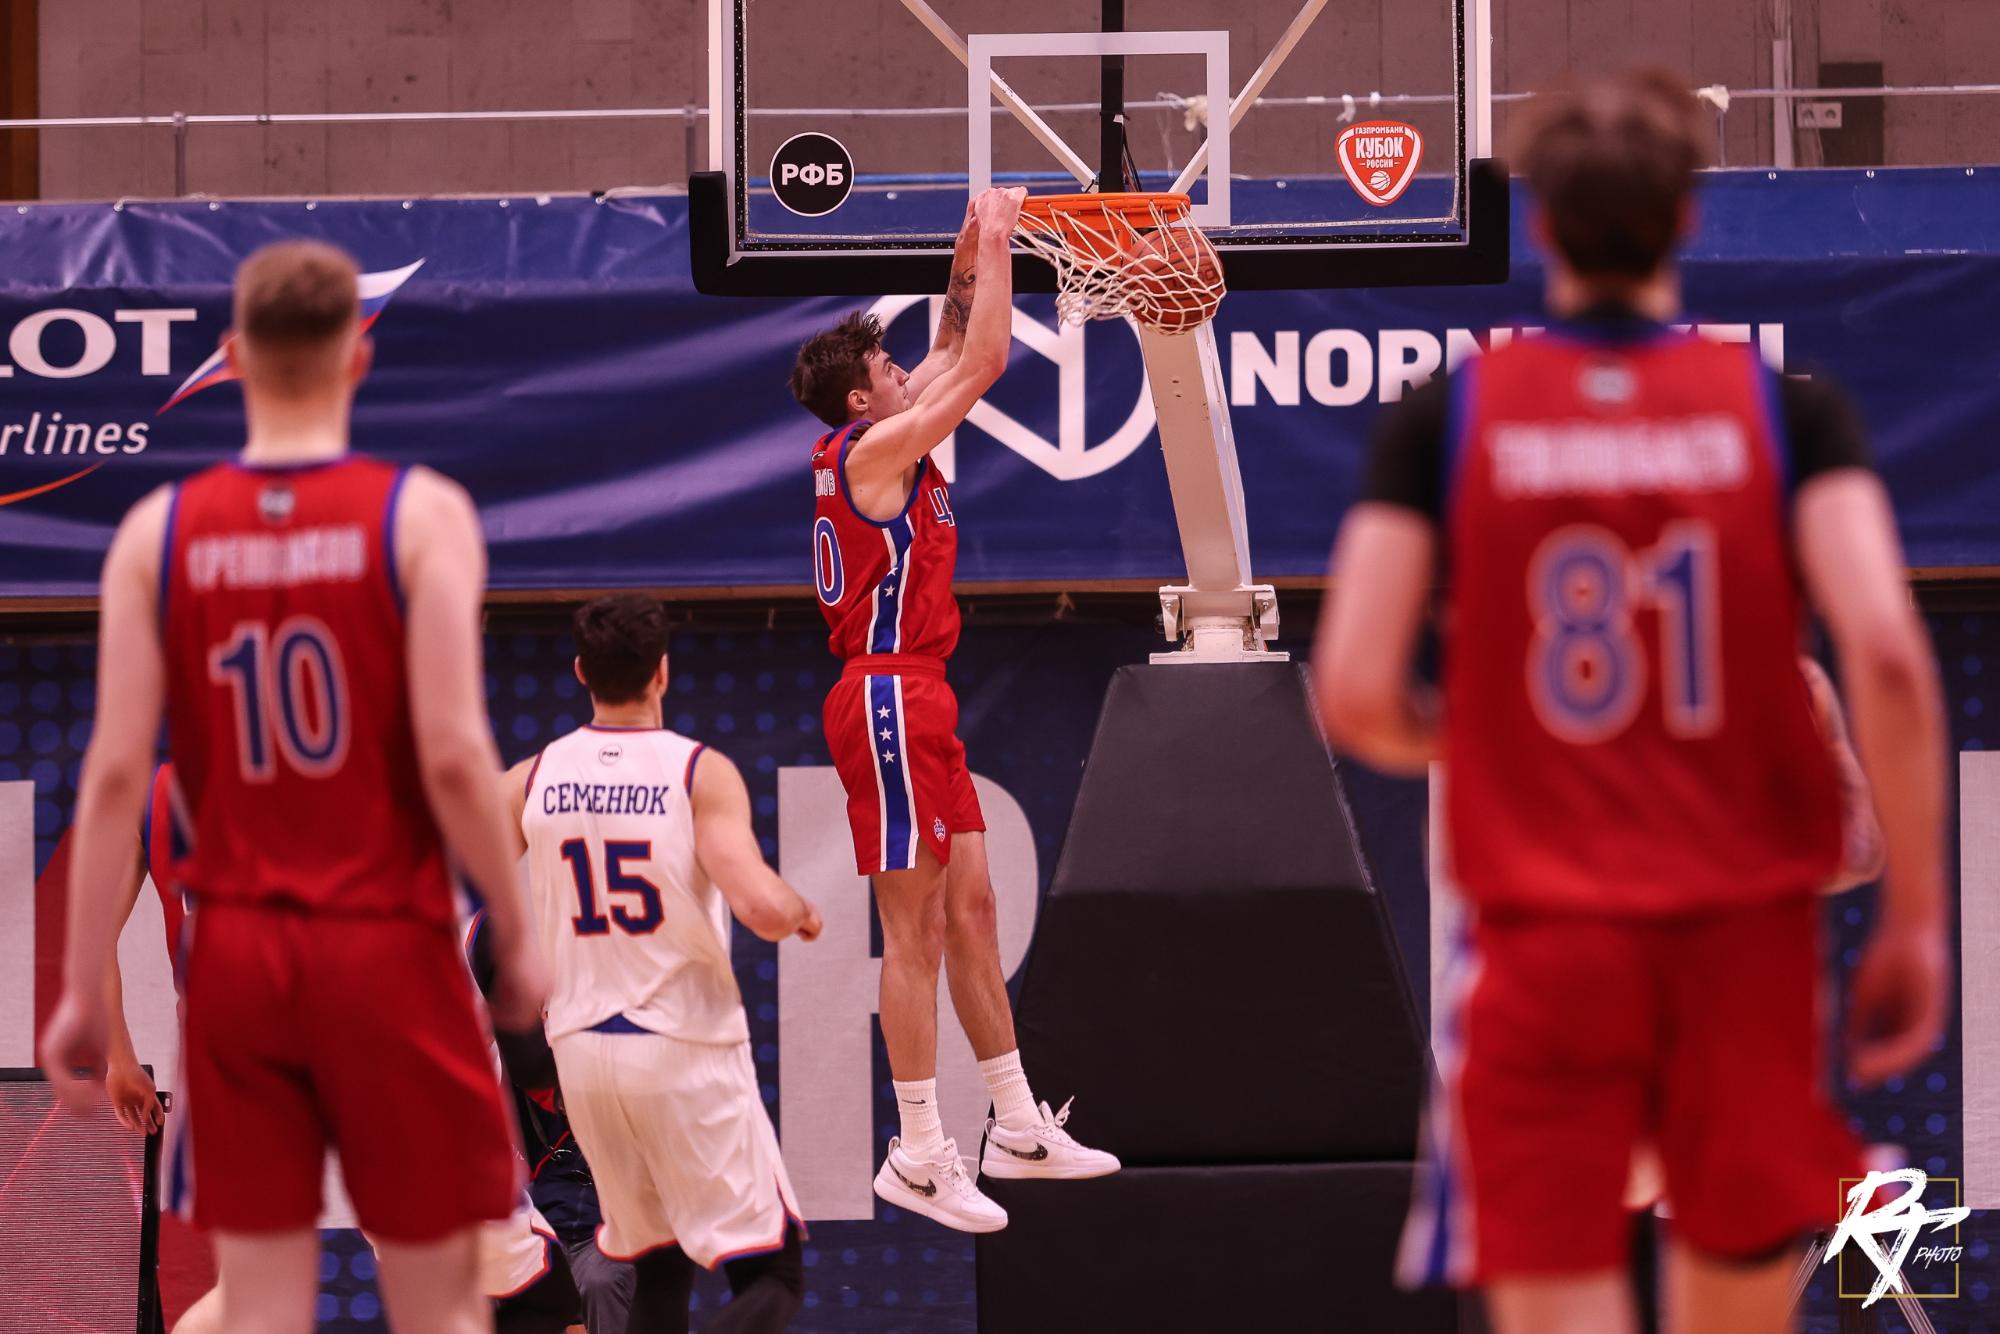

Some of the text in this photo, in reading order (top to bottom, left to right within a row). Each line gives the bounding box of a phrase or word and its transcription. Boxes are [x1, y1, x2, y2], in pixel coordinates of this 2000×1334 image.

[1355, 126, 1404, 134] ГАЗПРОМБАНК
[1355, 136, 1404, 158] КУБОК
[781, 163, 844, 186] РФБ
[1366, 159, 1394, 169] РОССИИ
[1526, 518, 1724, 743] 81
[208, 615, 350, 784] 10
[543, 782, 669, 815] СЕМЕНЮК
[560, 837, 665, 937] 15
